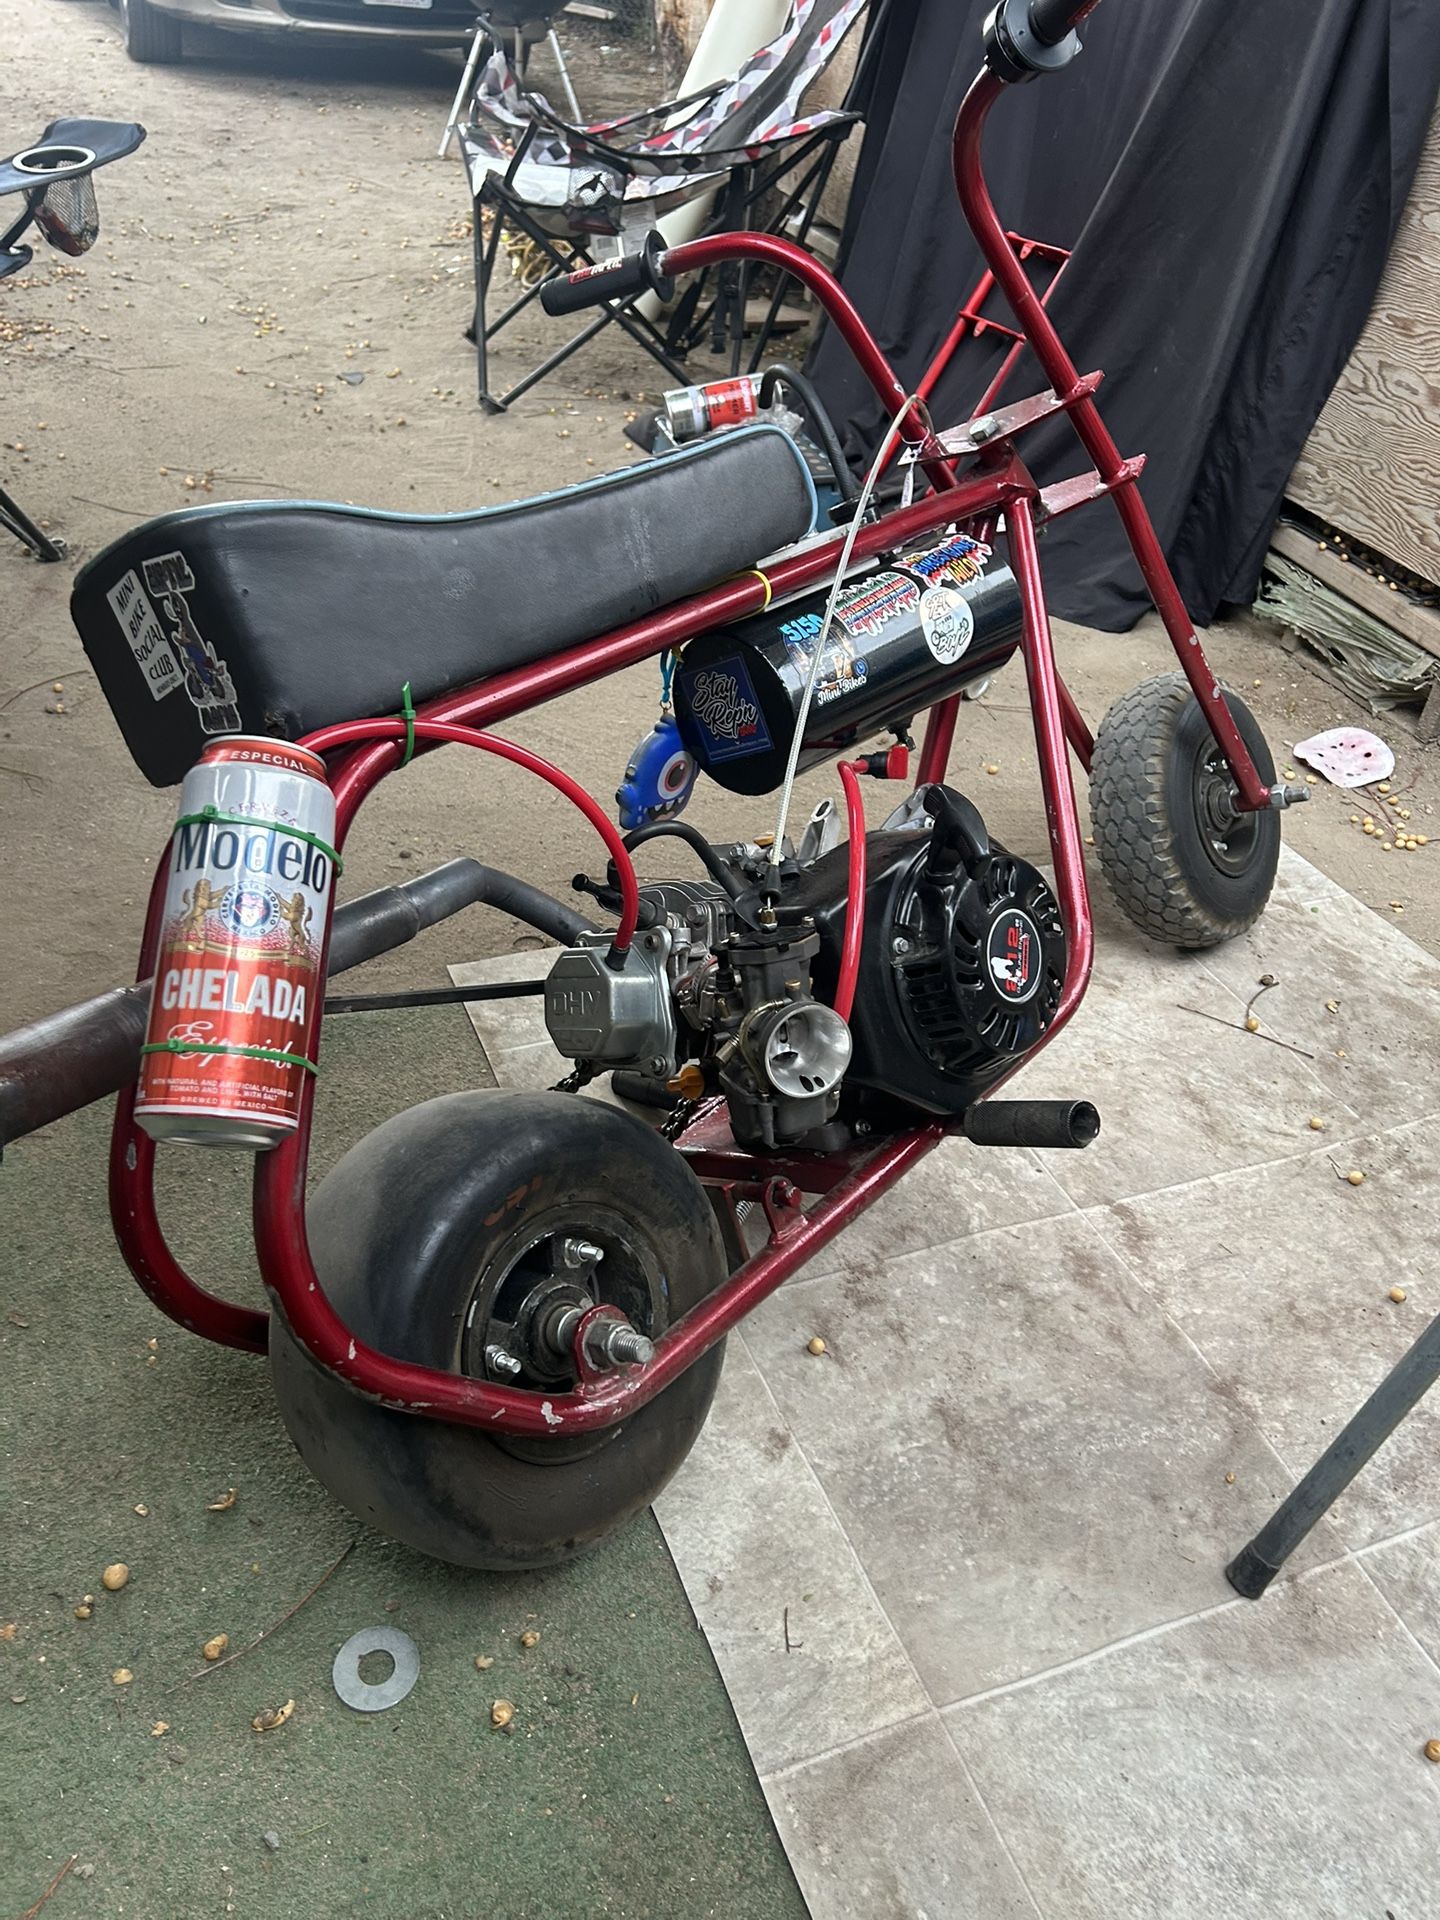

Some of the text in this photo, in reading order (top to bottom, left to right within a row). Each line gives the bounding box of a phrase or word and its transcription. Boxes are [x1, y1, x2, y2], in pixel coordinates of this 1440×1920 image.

[115, 575, 135, 615] MINI
[128, 598, 147, 640] BIKE
[134, 623, 166, 662] SOCIAL
[149, 653, 175, 681] CLUB
[692, 671, 739, 712] Stay
[817, 674, 867, 706] Mini Bikes
[229, 751, 308, 773] ESPECIAL
[175, 815, 327, 893] Modelo
[161, 968, 306, 1026] CHELADA
[170, 1085, 200, 1093] TOMATO
[201, 1086, 218, 1095] AND
[243, 1089, 262, 1099] WITH
[263, 1092, 278, 1101] SALT
[180, 1096, 218, 1104] BREWED
[234, 1099, 267, 1110] MEXICO
[201, 1079, 218, 1087] AND
[220, 1080, 261, 1092] ARTIFICIAL
